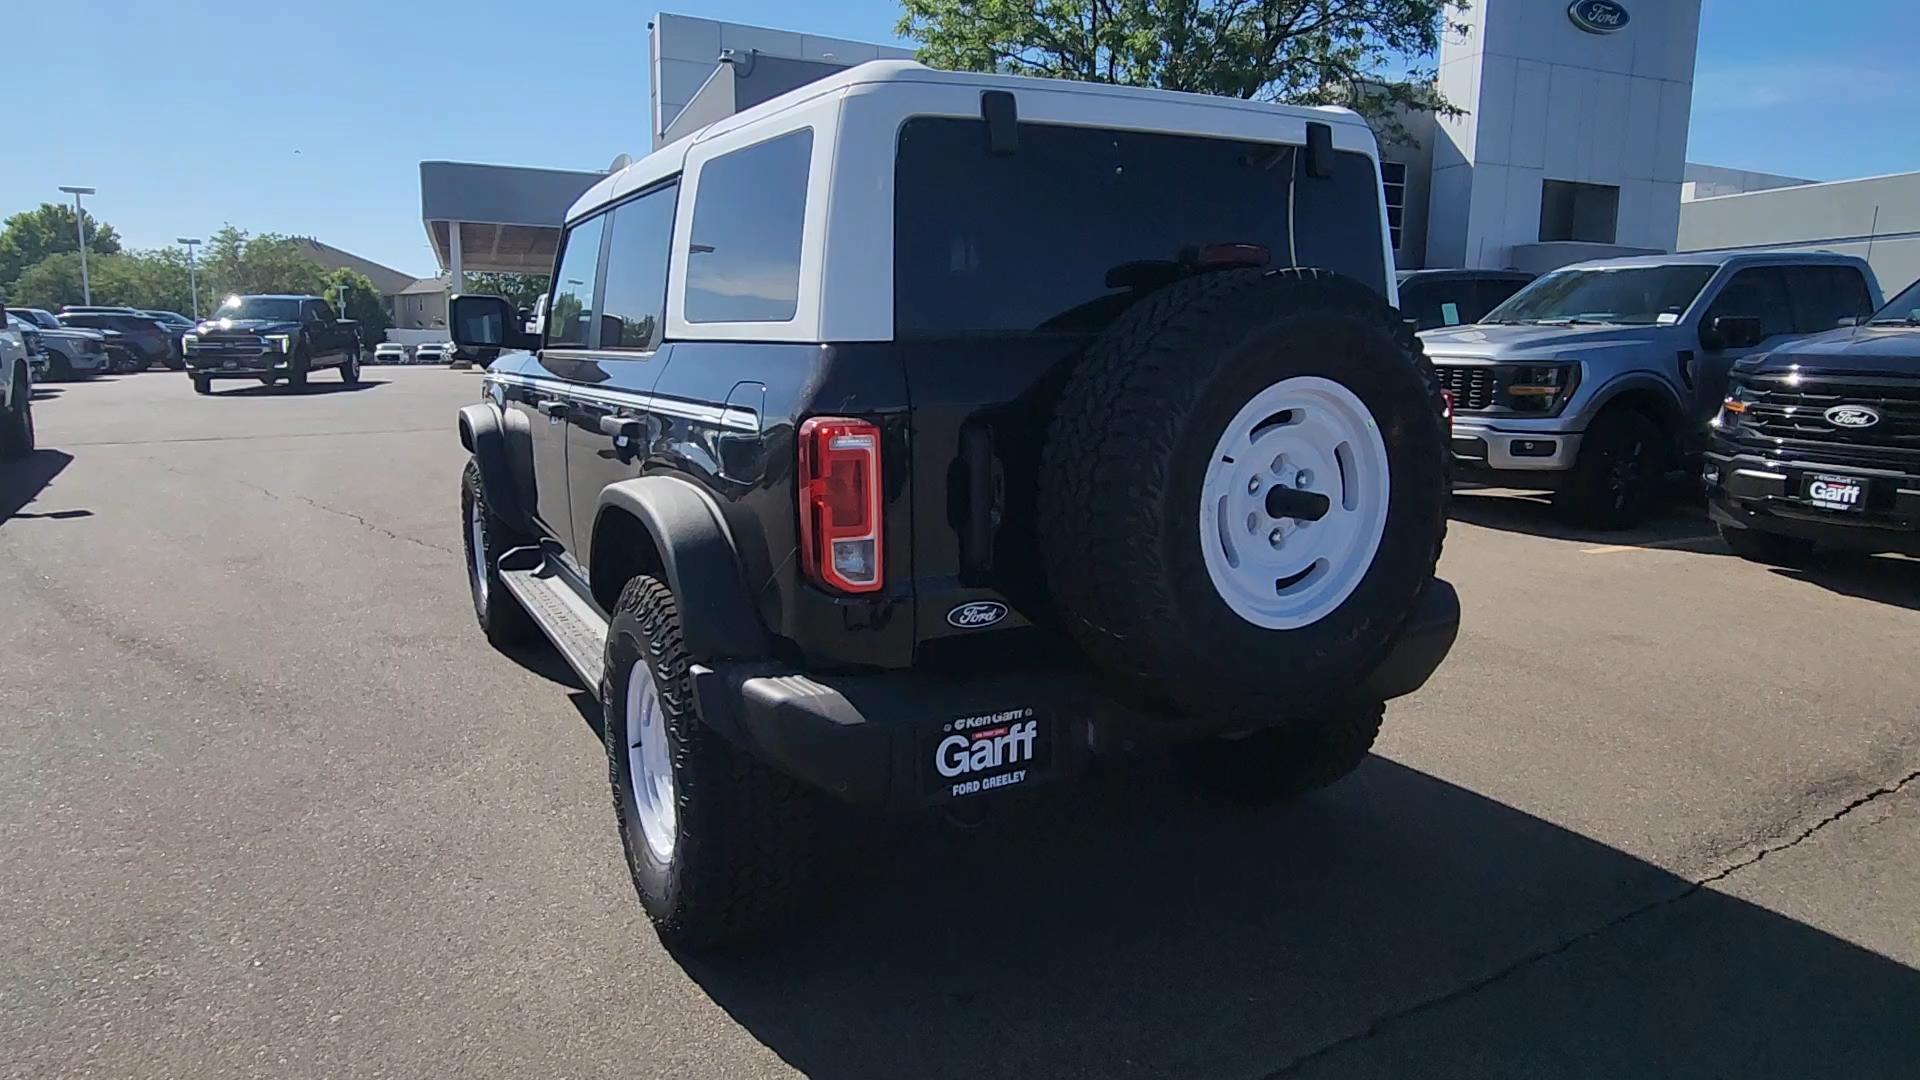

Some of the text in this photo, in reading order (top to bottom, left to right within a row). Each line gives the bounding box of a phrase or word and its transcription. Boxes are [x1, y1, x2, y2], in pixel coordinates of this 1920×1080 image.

[1588, 3, 1620, 25] Ford
[1810, 481, 1860, 504] Garff
[960, 606, 998, 624] Ford
[966, 715, 991, 729] Ken
[935, 720, 1037, 777] Garff
[952, 769, 1027, 797] FORD GREELEY
